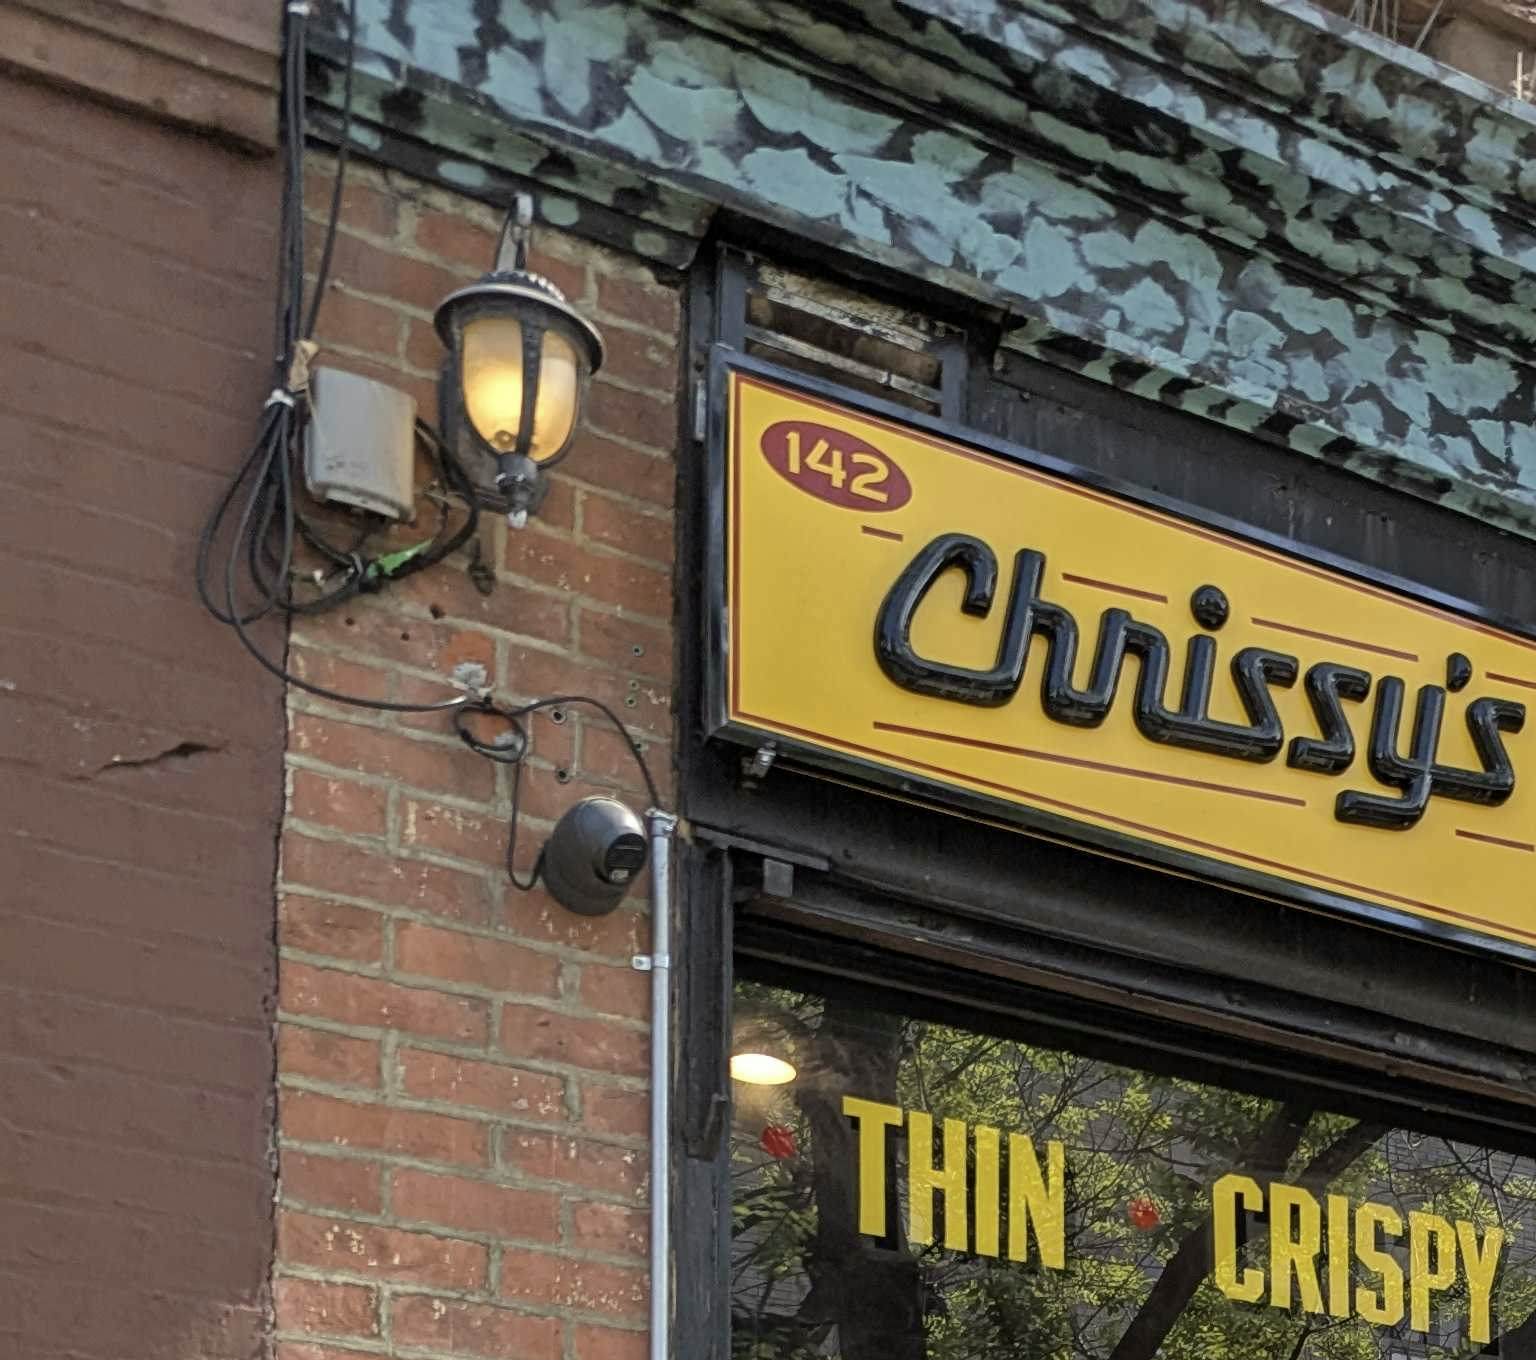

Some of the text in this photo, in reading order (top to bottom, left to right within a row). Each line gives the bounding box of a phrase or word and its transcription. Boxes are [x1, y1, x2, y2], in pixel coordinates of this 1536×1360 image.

[786, 430, 892, 504] 142
[873, 531, 1528, 831] Chrissy's
[842, 1095, 1069, 1270] THIN
[1213, 1172, 1503, 1345] CRISPY
